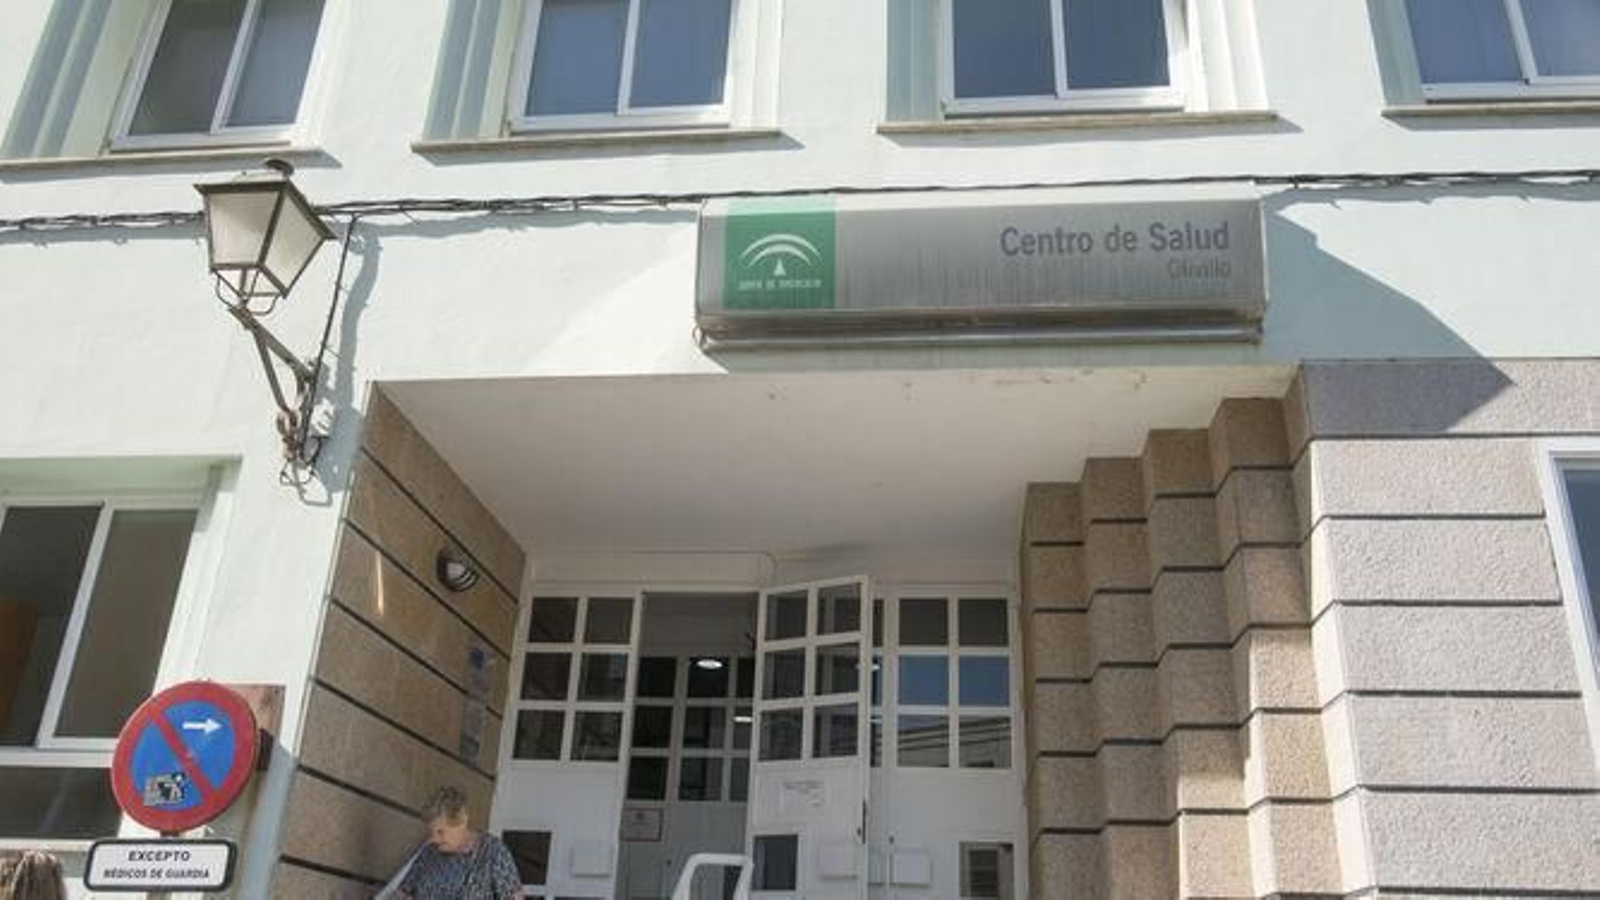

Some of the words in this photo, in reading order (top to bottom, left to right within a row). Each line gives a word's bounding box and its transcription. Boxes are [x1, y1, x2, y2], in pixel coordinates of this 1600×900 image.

[1000, 226, 1094, 257] Centro
[1104, 223, 1137, 252] de
[1149, 221, 1229, 251] Salud
[128, 850, 191, 861] EXCEPTO
[150, 868, 163, 878] DE
[165, 867, 210, 878] GUARDIA
